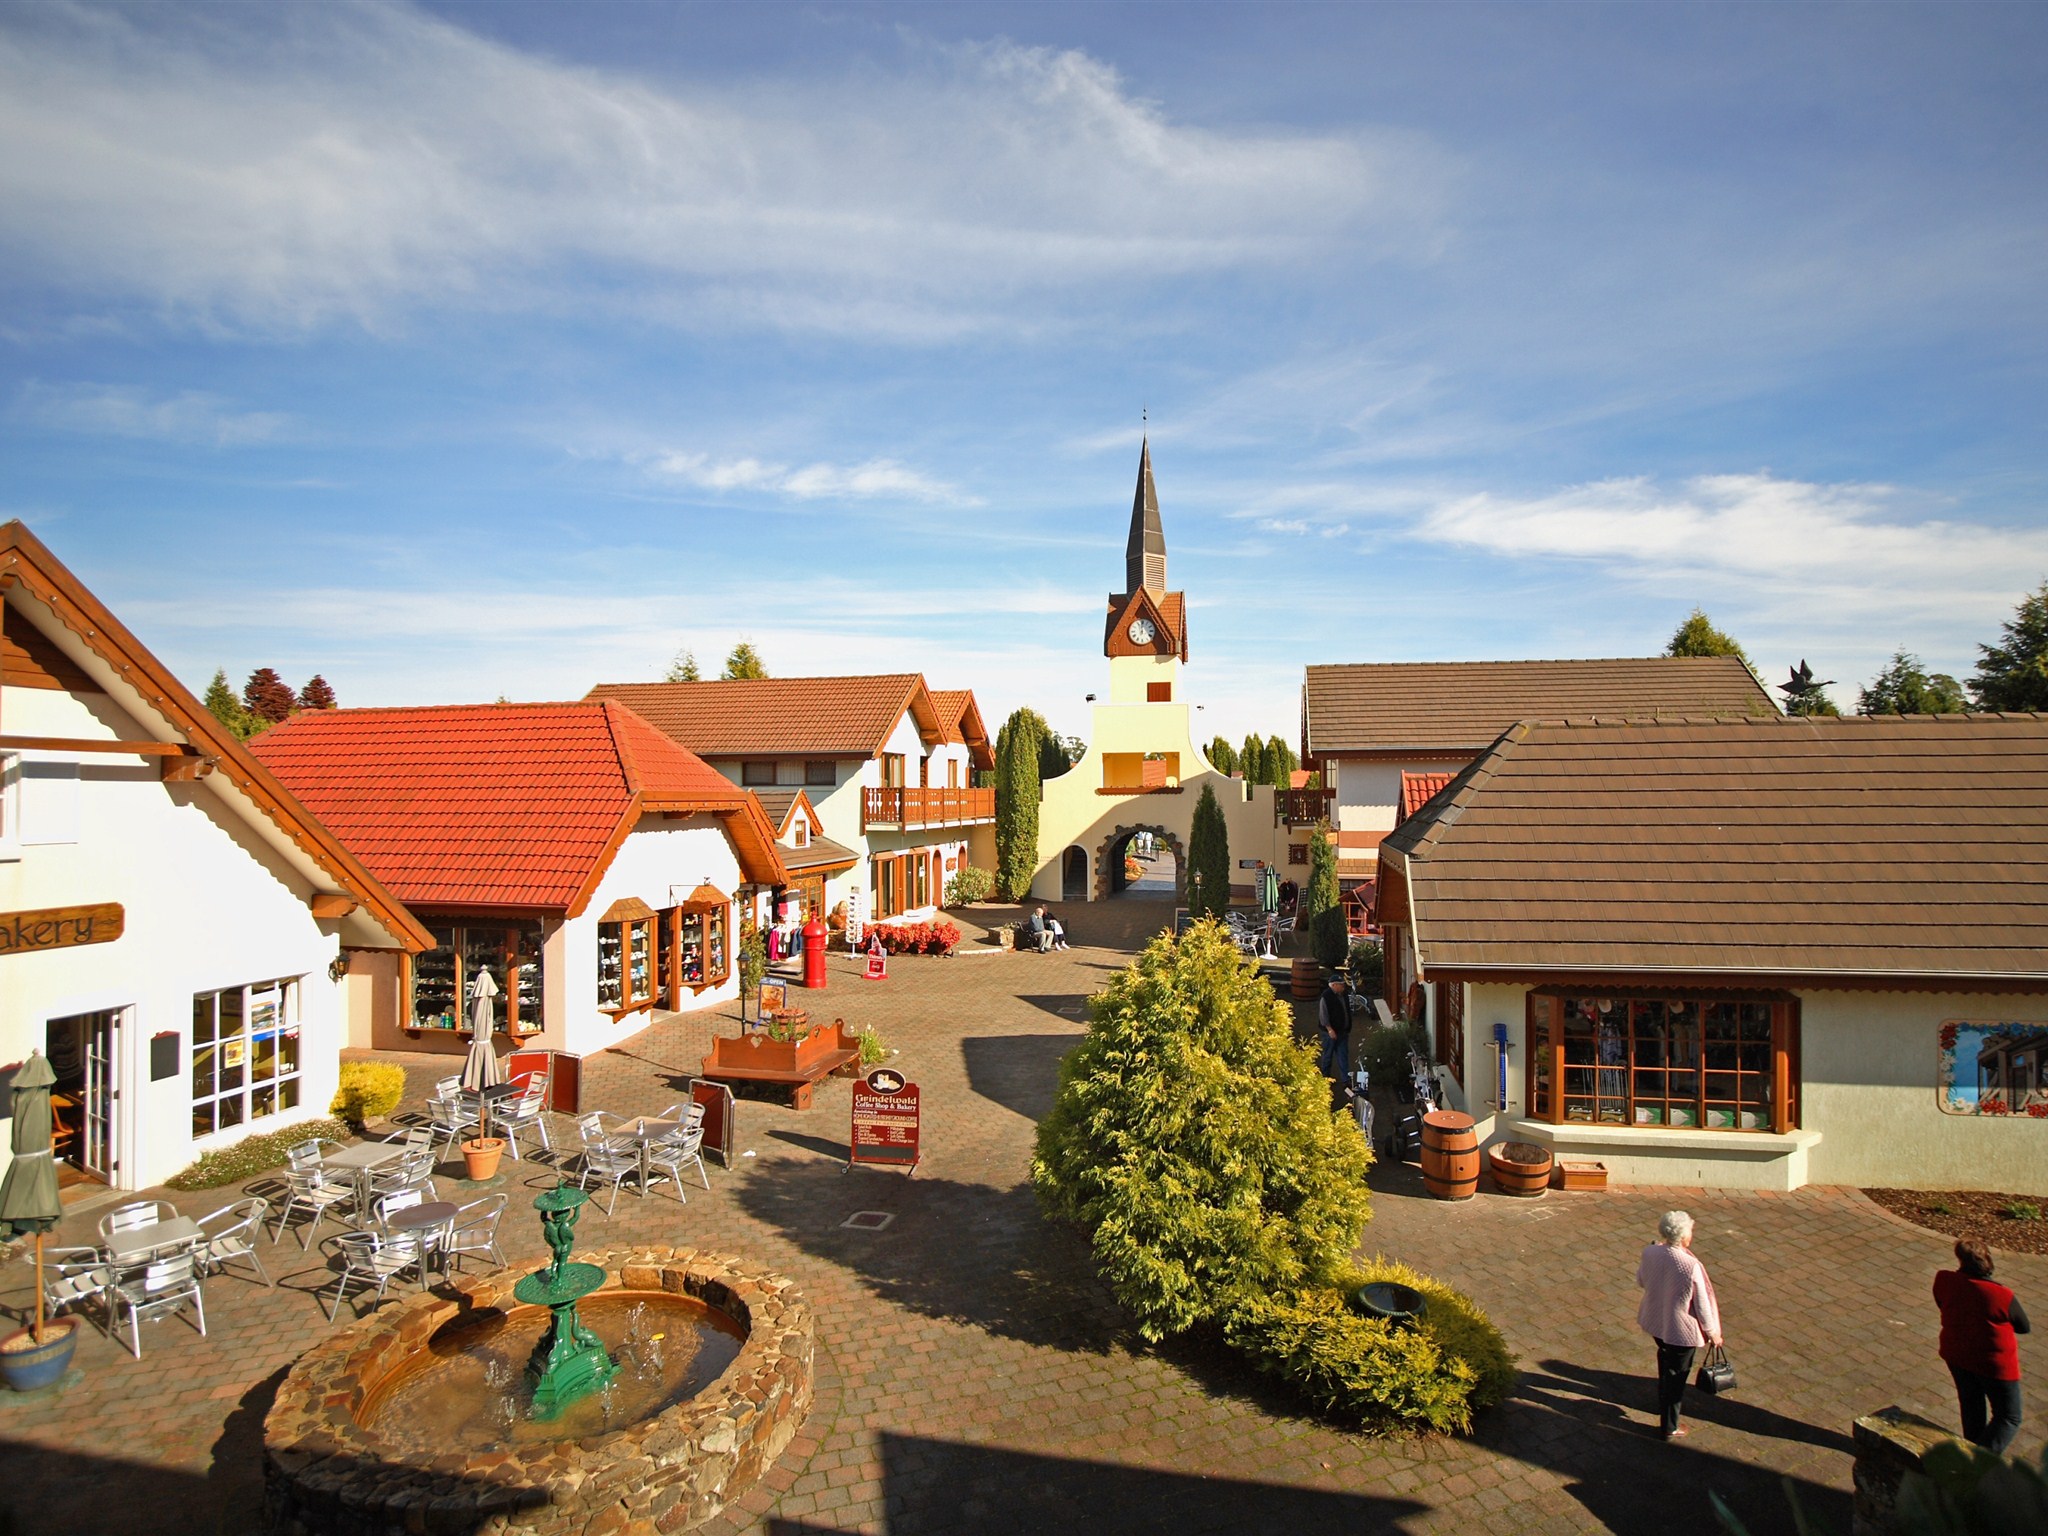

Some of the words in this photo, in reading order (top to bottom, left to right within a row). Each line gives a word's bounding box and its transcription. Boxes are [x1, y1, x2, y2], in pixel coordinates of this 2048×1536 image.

[855, 1094, 917, 1105] Grindelwald
[875, 1102, 889, 1110] Shop
[897, 1103, 917, 1111] Bakery
